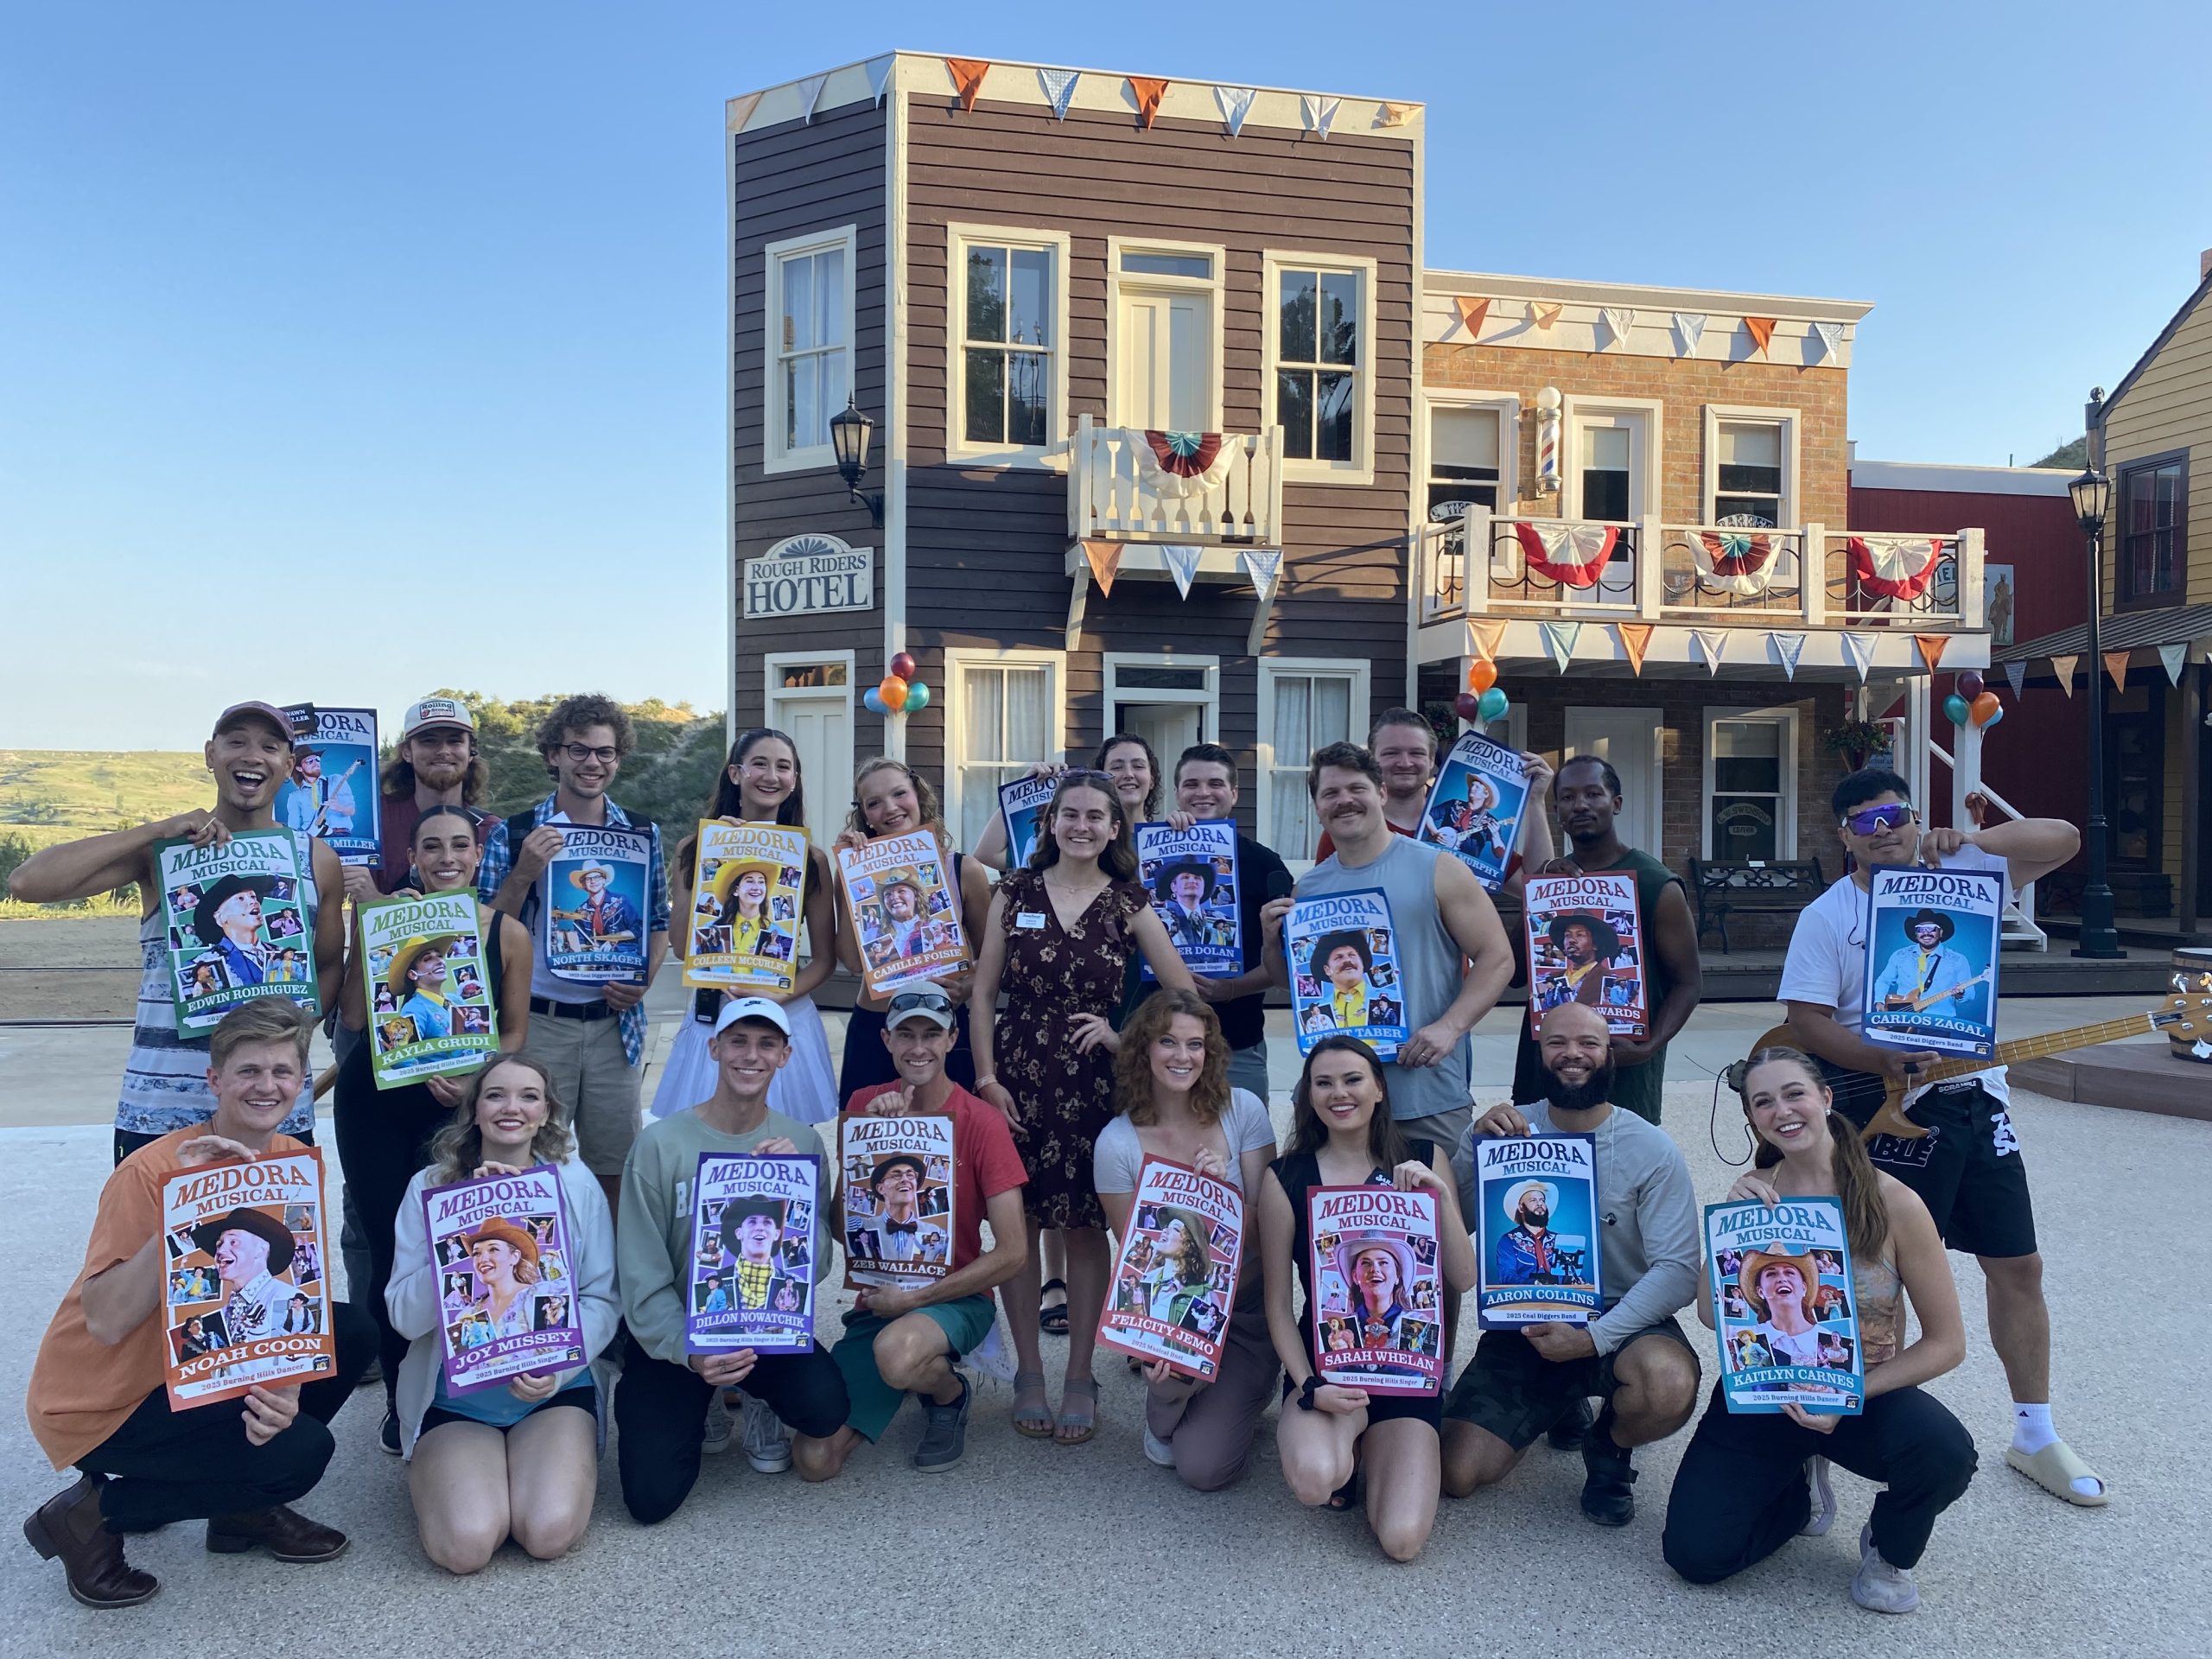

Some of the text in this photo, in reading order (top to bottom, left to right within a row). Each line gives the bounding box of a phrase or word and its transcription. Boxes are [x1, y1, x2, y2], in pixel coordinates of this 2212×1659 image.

[751, 555, 867, 579] ROUGH RIDERS
[747, 573, 868, 613] HOTEL
[1456, 740, 1524, 778] MEDORA
[1464, 754, 1512, 780] MUSICAL
[334, 840, 376, 850] MILLER
[707, 829, 800, 855] MEDORA
[1142, 827, 1230, 849] MEDORA
[1159, 842, 1216, 856] MUSICAL
[169, 842, 288, 874] MEDORA
[569, 847, 630, 860] MUSICAL
[722, 846, 784, 861] MUSICAL
[846, 837, 932, 869] MEDORA
[863, 853, 919, 874] MUSICAL
[192, 861, 270, 880] MUSICAL
[1532, 879, 1630, 902] MEDORA
[1878, 875, 1993, 903] MEDORA
[1292, 898, 1383, 926] MEDORA
[1550, 895, 1613, 908] MUSICAL
[1898, 894, 1974, 911] MUSICAL
[369, 901, 471, 936] MEDORA
[389, 919, 454, 941] MUSICAL
[1309, 915, 1370, 932] MUSICAL
[553, 953, 643, 966] NORTH SKAGER
[1194, 946, 1234, 957] DOLAN
[693, 955, 788, 972] COLLEEN MCCURLEY
[874, 948, 962, 979] CAMILLE FOISIE
[187, 984, 308, 1013] EDWIN RODRIGUEZ
[1355, 1027, 1403, 1038] TABER
[1871, 1014, 1986, 1038] CARLOS ZAGAL
[382, 1036, 490, 1065] KAYLA GRUDI
[1922, 1038, 1945, 1047] Diggers
[849, 1119, 948, 1143] MEDORA
[865, 1139, 931, 1153] MUSICAL
[1484, 1141, 1589, 1167] MEDORA
[705, 1161, 810, 1186] MEDORA
[1503, 1160, 1571, 1176] MUSICAL
[171, 1164, 312, 1211] MEDORA
[722, 1181, 791, 1195] MUSICAL
[1146, 1171, 1239, 1218] MEDORA
[196, 1188, 289, 1217] MUSICAL
[435, 1180, 553, 1223] MEDORA
[1161, 1192, 1224, 1222] MUSICAL
[1319, 1193, 1430, 1222] MEDORA
[458, 1201, 534, 1228] MUSICAL
[1338, 1215, 1411, 1230] MUSICAL
[1715, 1205, 1836, 1237] MEDORA
[1736, 1227, 1815, 1245] MUSICAL
[852, 1260, 946, 1276] ZEB WALLACE
[1486, 1289, 1595, 1306] AARON COLLINS
[696, 1312, 804, 1329] DILLON NOWATCHIK
[1537, 1313, 1560, 1321] Diggers
[1110, 1313, 1214, 1356] FELICITY JEMO
[179, 1338, 322, 1380] NOAH COON
[456, 1332, 573, 1370] JOY MISSEY
[1325, 1351, 1434, 1371] SARAH WHELAN
[201, 1381, 221, 1391] 2025
[222, 1375, 256, 1387] Burning
[257, 1370, 275, 1380] Hills
[276, 1363, 305, 1375] Dancer
[475, 1370, 493, 1380] 2025
[493, 1365, 519, 1376] Burning
[520, 1360, 537, 1370] Hills
[537, 1354, 558, 1366] Singer
[1733, 1369, 1855, 1388] KAITLYN CARNES
[1359, 1376, 1384, 1385] Burning
[1399, 1378, 1418, 1387] Singer
[1771, 1394, 1799, 1402] Burning
